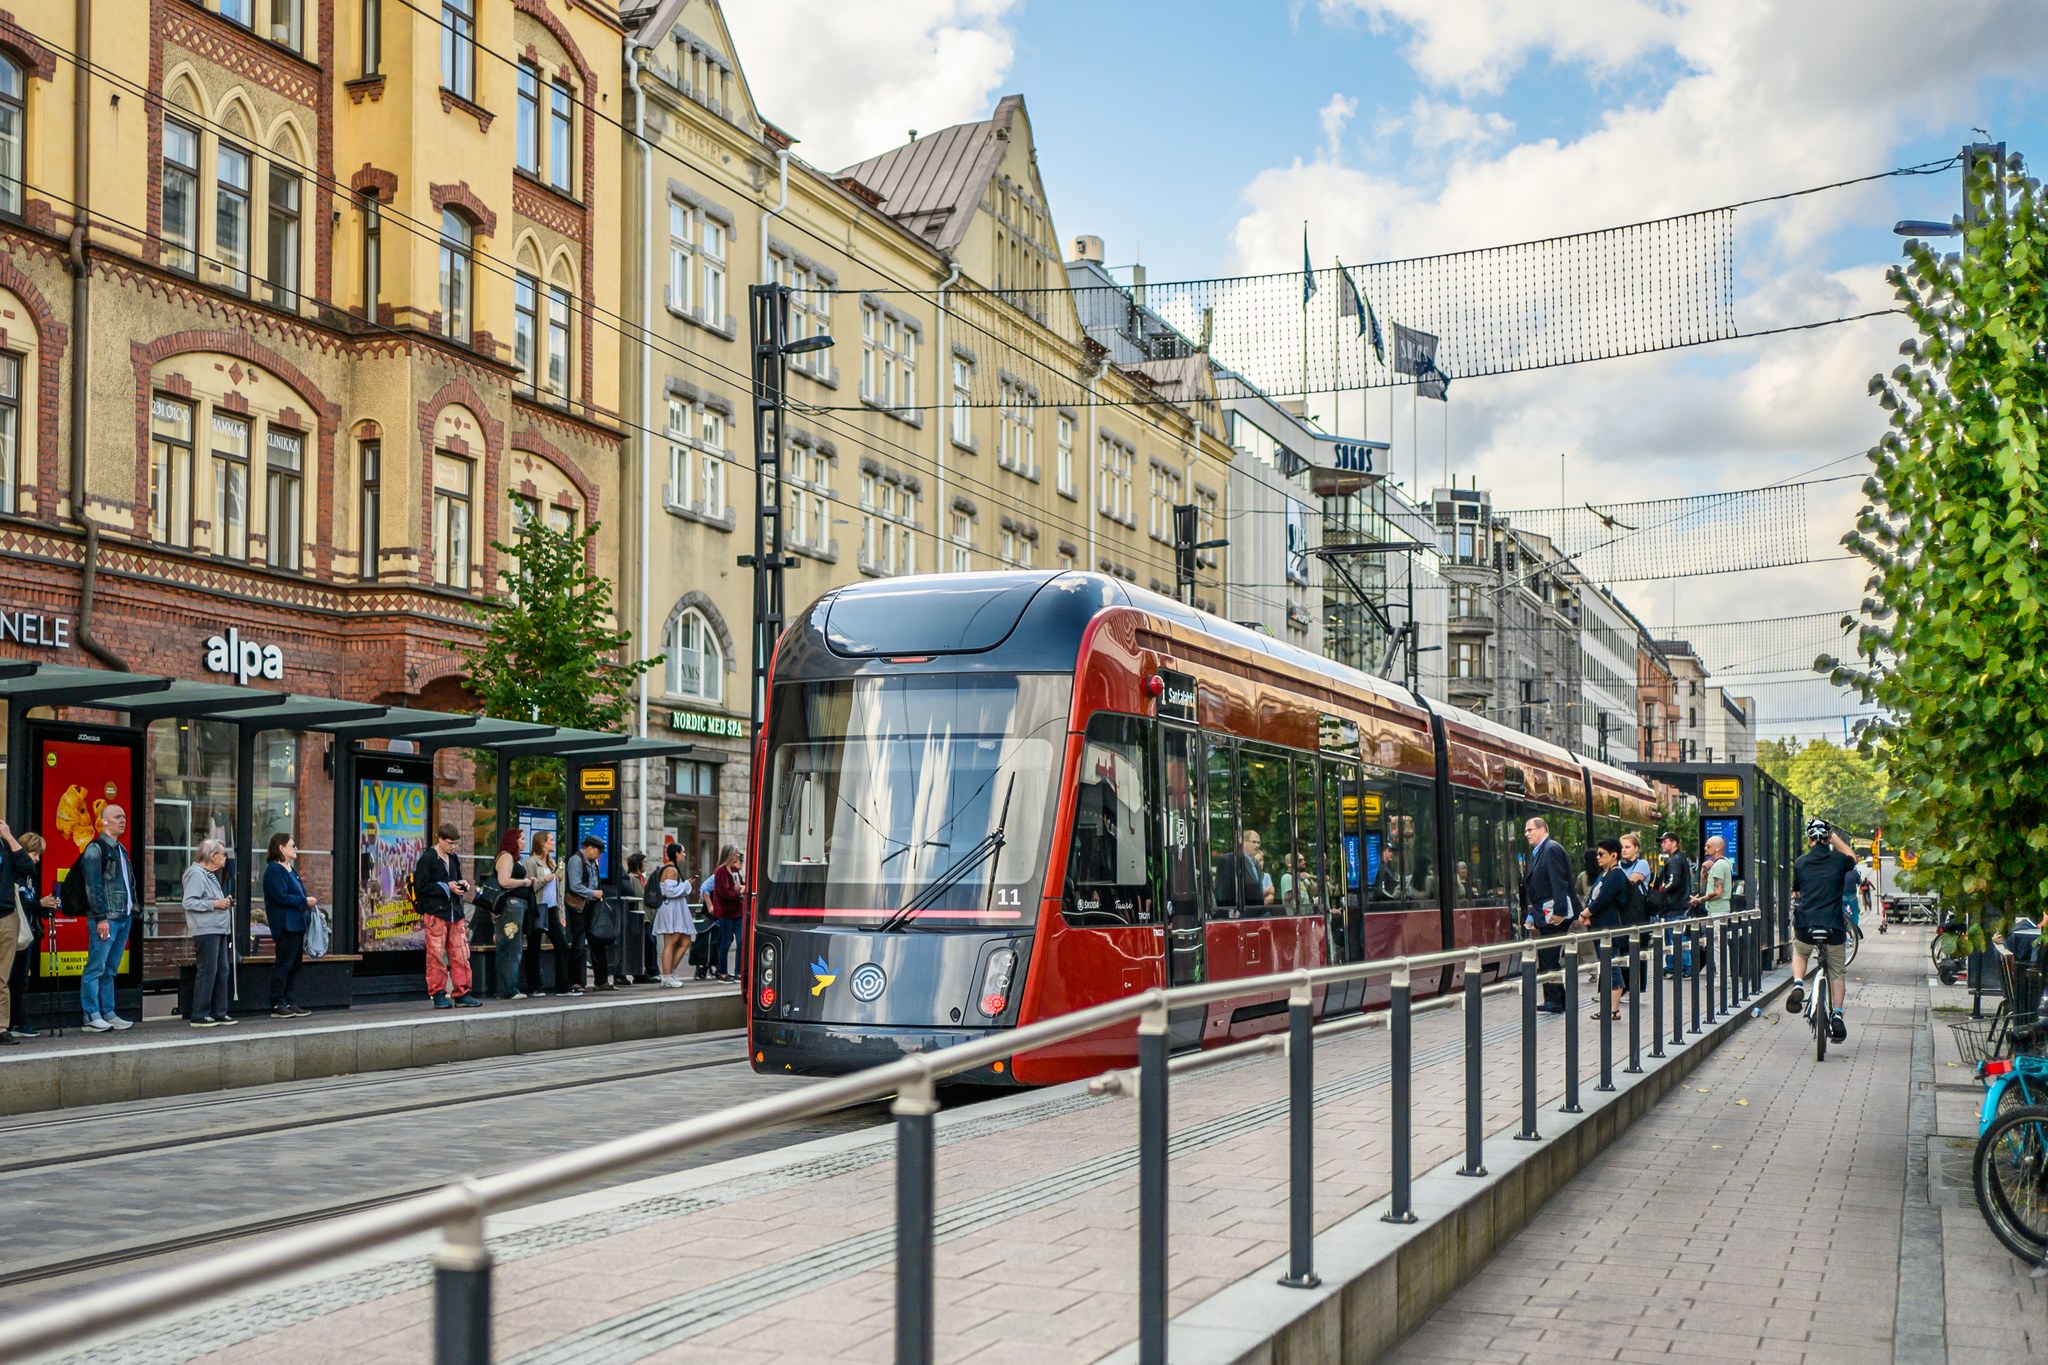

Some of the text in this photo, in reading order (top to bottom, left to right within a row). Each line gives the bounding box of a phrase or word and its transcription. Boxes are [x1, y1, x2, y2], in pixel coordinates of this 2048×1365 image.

[1335, 443, 1372, 472] SOKOS
[0, 610, 70, 648] NELE
[206, 627, 283, 685] alpa
[673, 711, 742, 737] NORDIC MED SPA
[363, 785, 425, 825] LYKO
[998, 888, 1021, 906] 11
